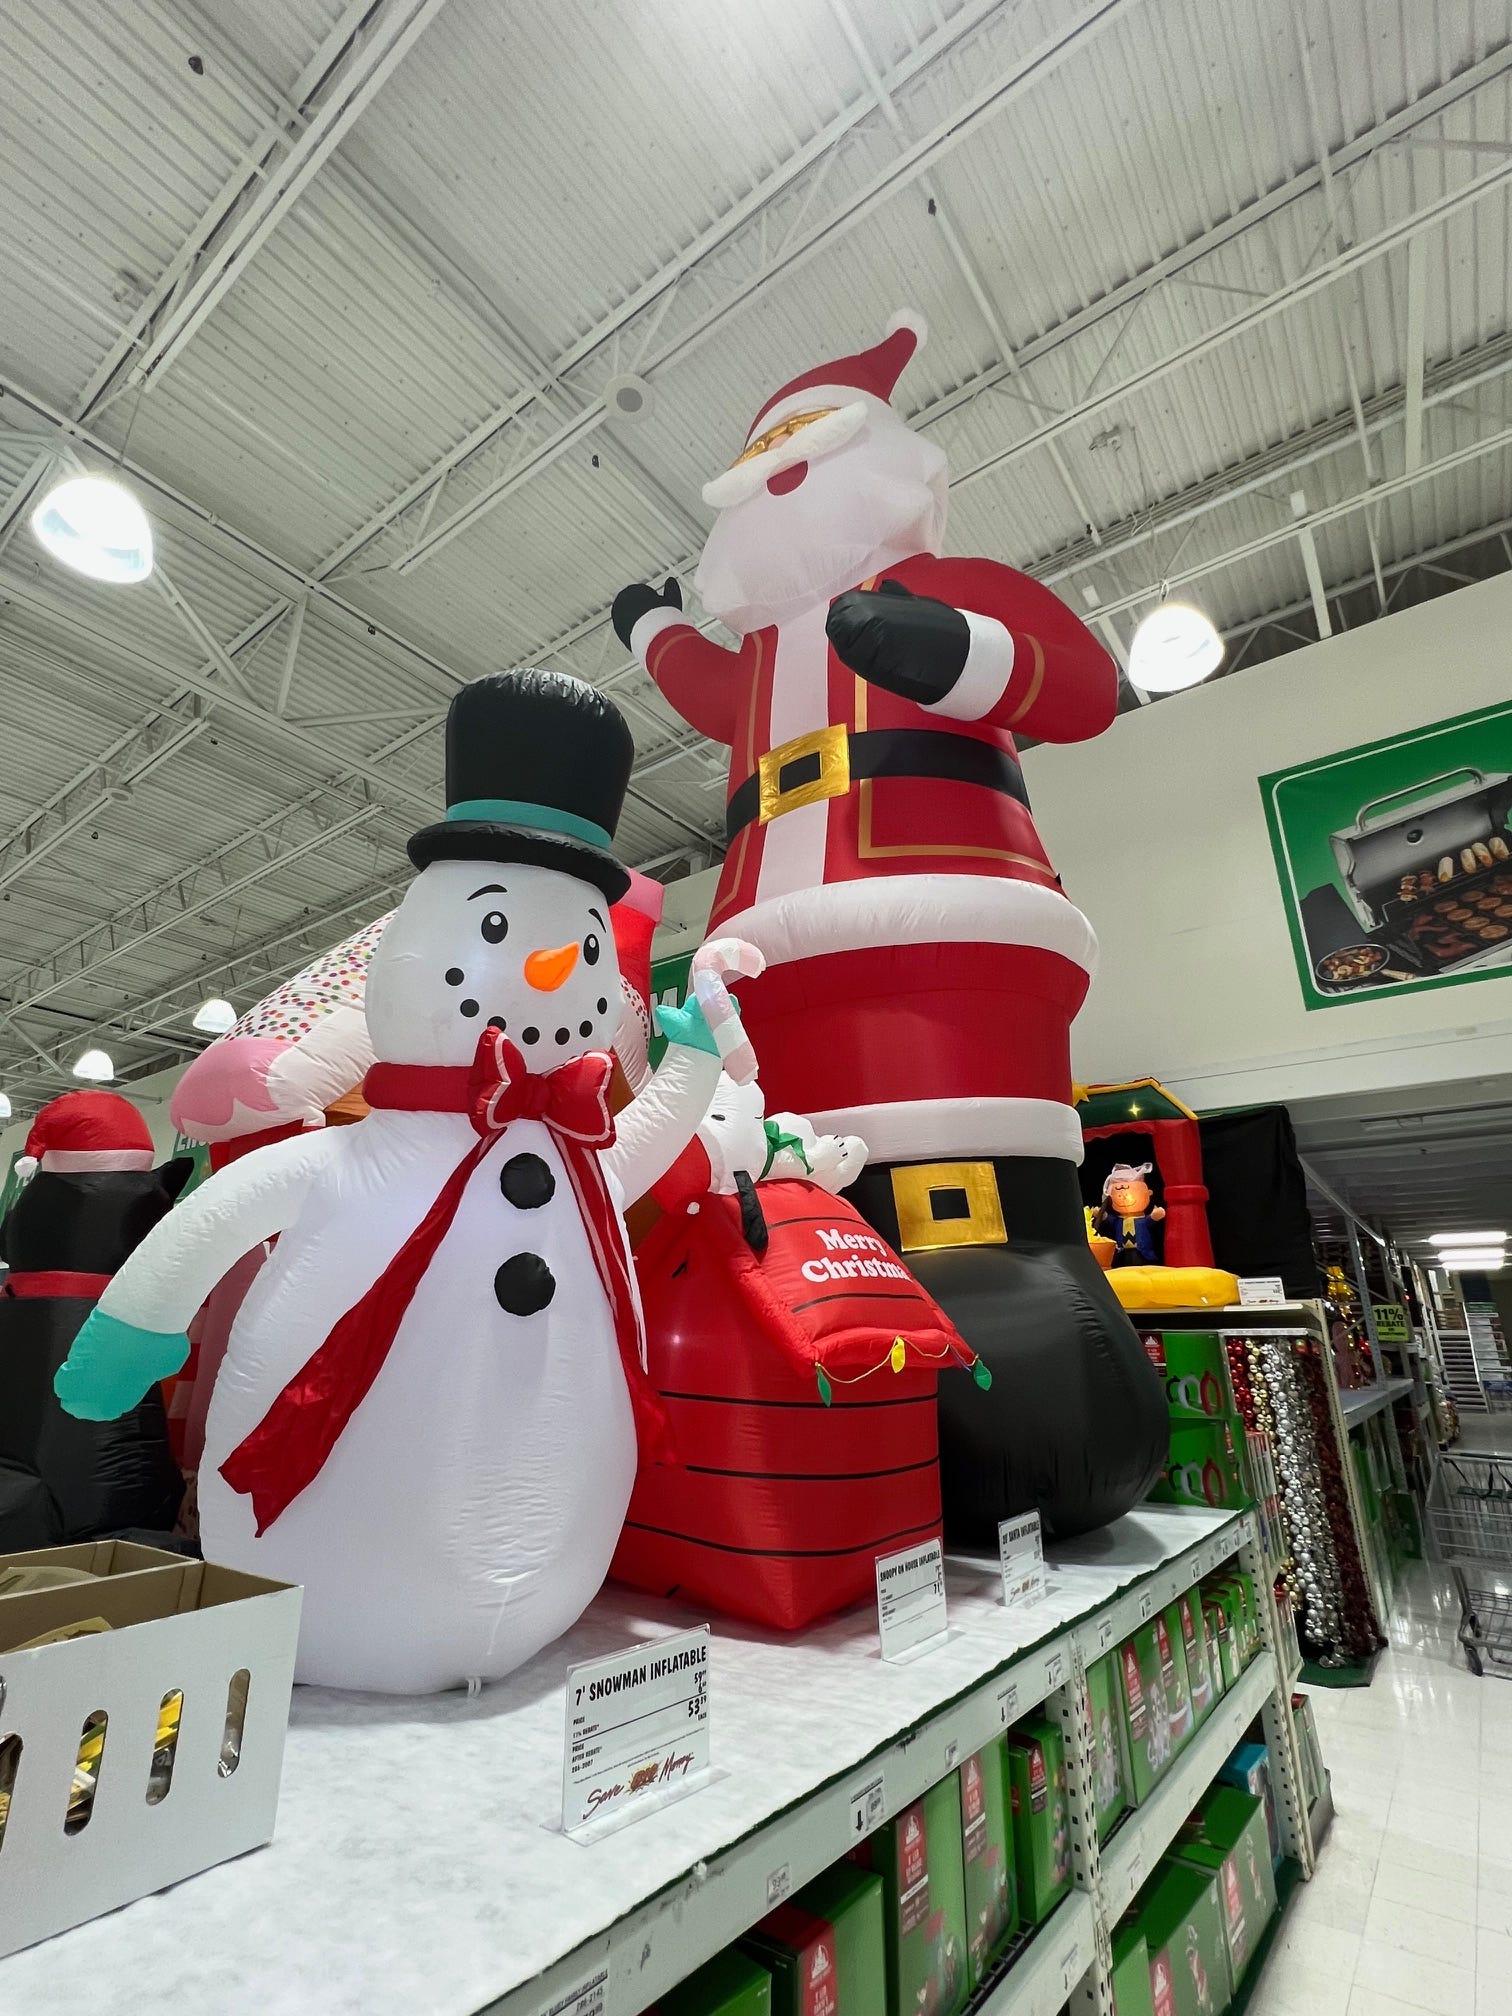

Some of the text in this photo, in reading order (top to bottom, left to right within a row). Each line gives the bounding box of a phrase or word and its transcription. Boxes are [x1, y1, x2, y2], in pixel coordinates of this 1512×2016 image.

[815, 1228, 887, 1257] Merry
[801, 1254, 913, 1283] Christma
[1374, 1308, 1404, 1321] 11%
[880, 1566, 898, 1582] SNOOPY
[905, 1558, 919, 1572] HOUSE
[919, 1549, 941, 1567] INFLATABLE
[575, 1646, 707, 1706] 7' SNOWMAN INFLATABLE
[583, 1784, 624, 1820] Save
[659, 1752, 695, 1782] Money
